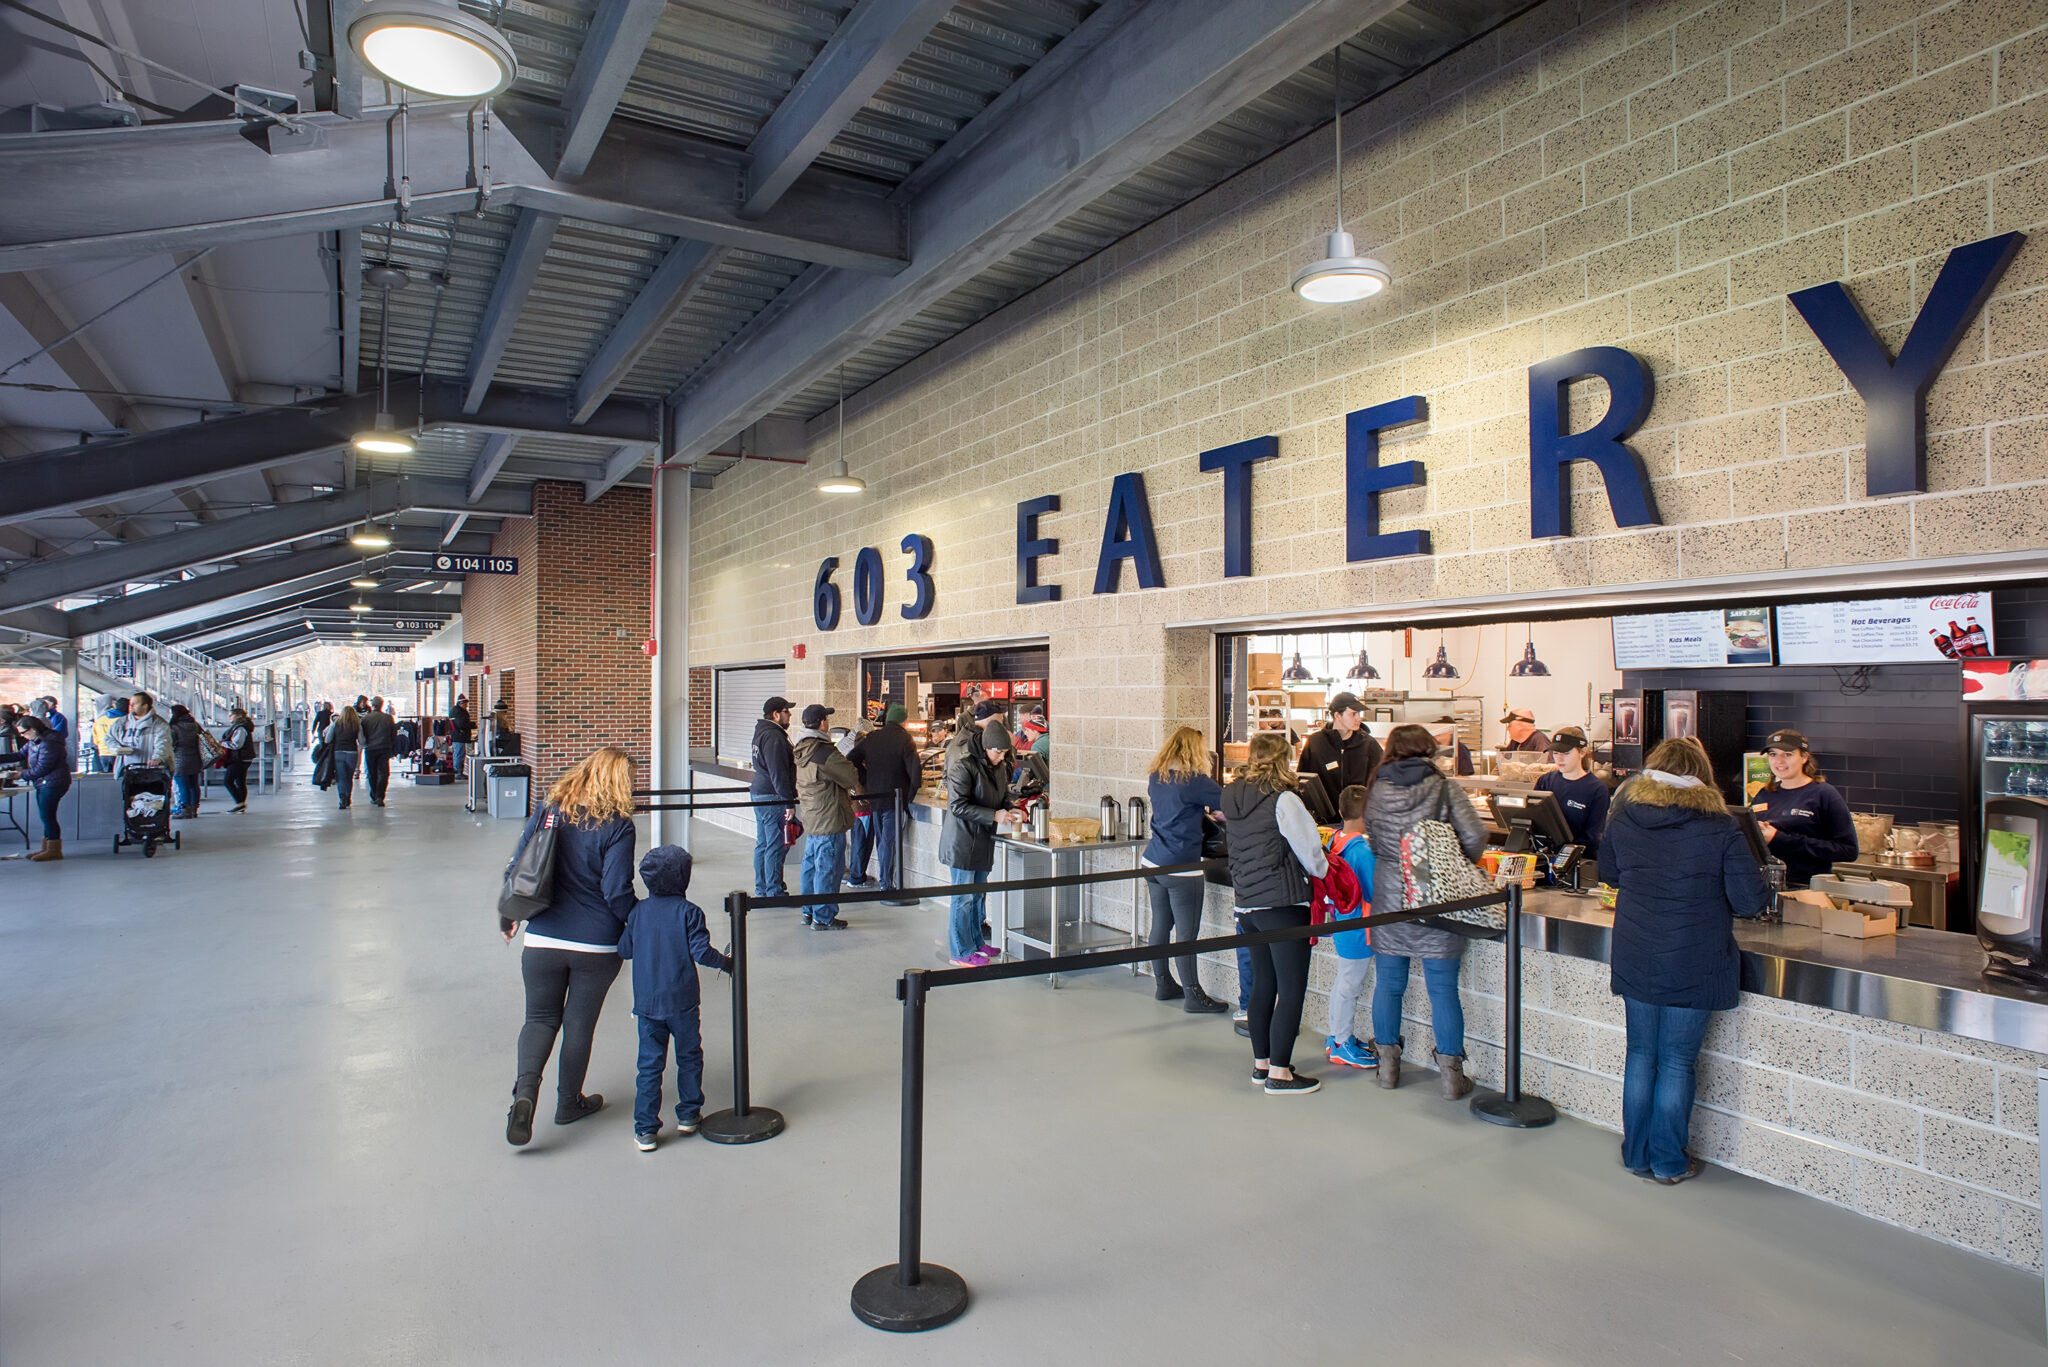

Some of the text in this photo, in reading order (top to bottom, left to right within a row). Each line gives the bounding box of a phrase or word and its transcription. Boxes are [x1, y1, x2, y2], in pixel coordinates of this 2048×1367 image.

[813, 230, 2028, 631] 603 EATERY
[455, 558, 513, 572] 104 105
[1868, 617, 1912, 625] Beverages
